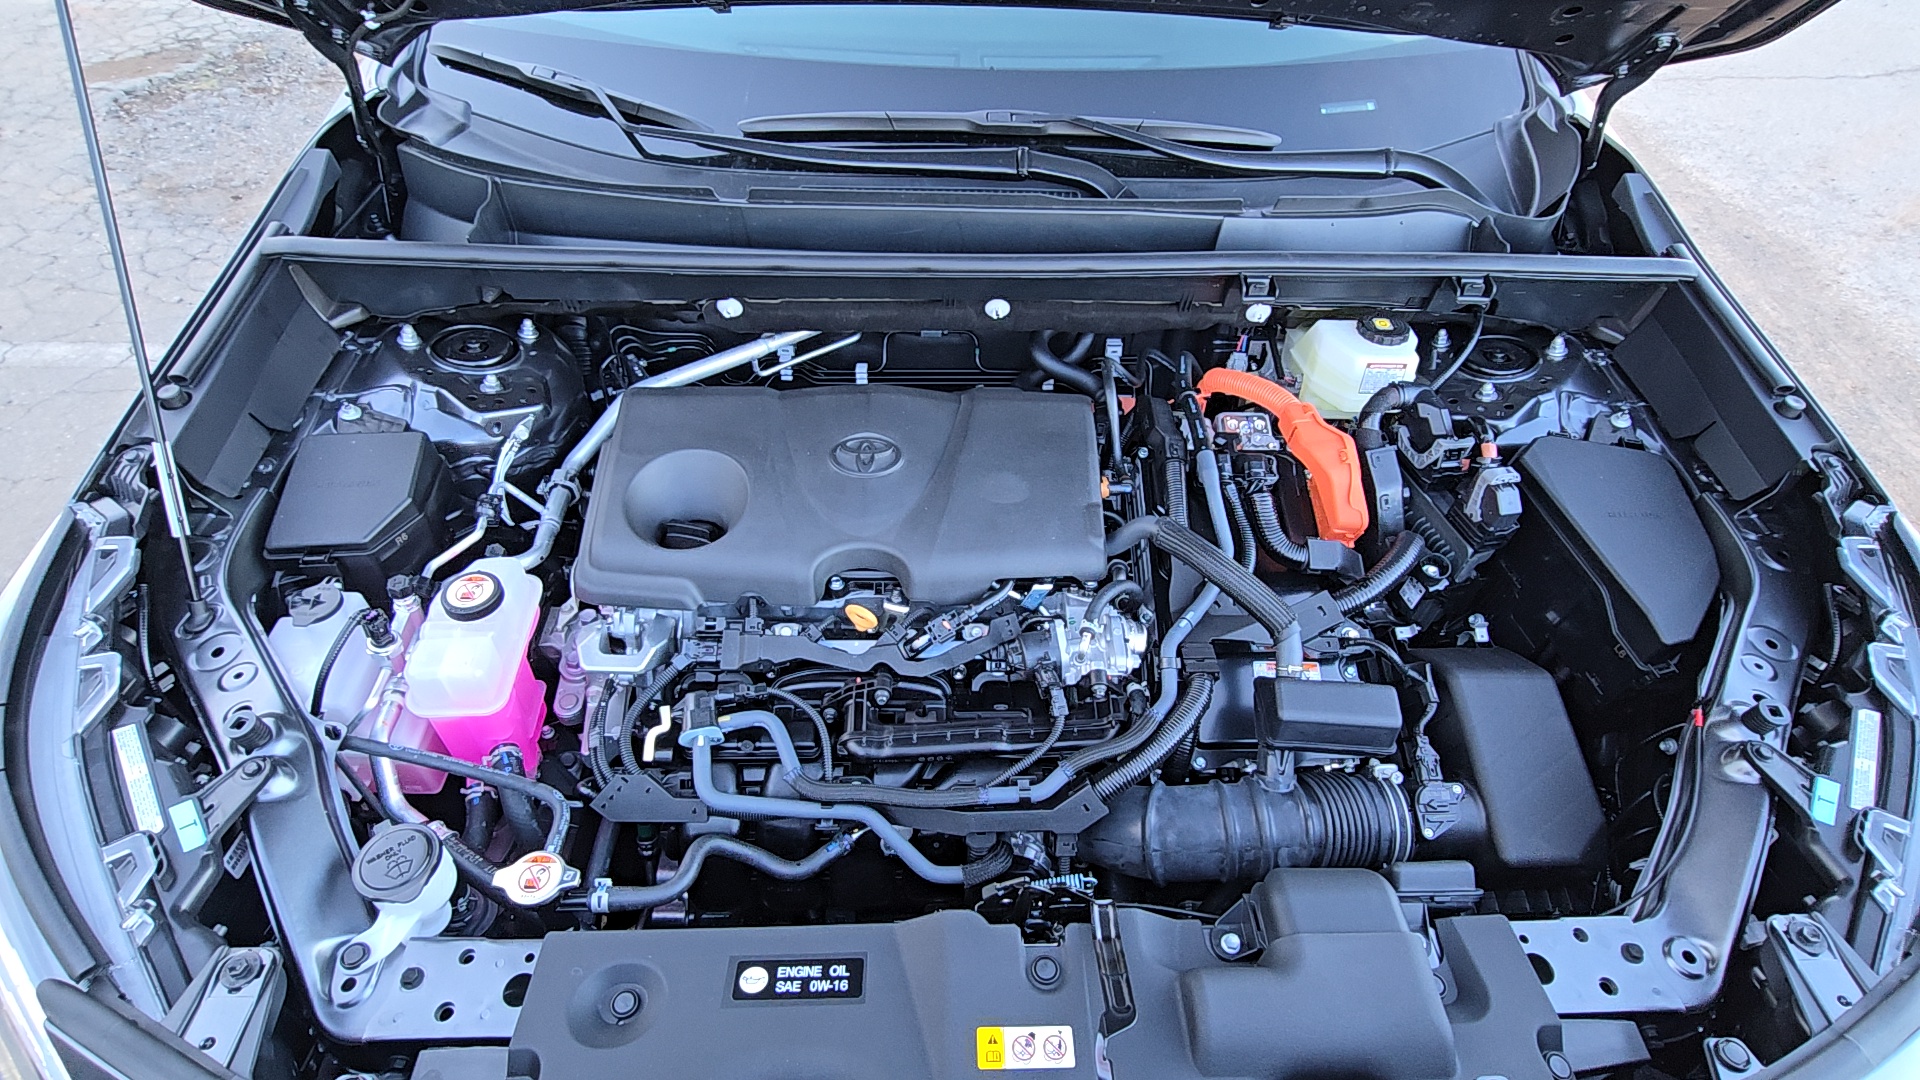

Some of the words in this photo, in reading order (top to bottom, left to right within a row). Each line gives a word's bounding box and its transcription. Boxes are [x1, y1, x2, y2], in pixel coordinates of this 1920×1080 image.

[394, 532, 409, 546] R6
[1613, 643, 1627, 659] L6
[776, 965, 823, 979] ENGINE
[828, 964, 851, 978] OIL
[774, 980, 802, 993] SAE
[808, 979, 849, 992] 0W-16
